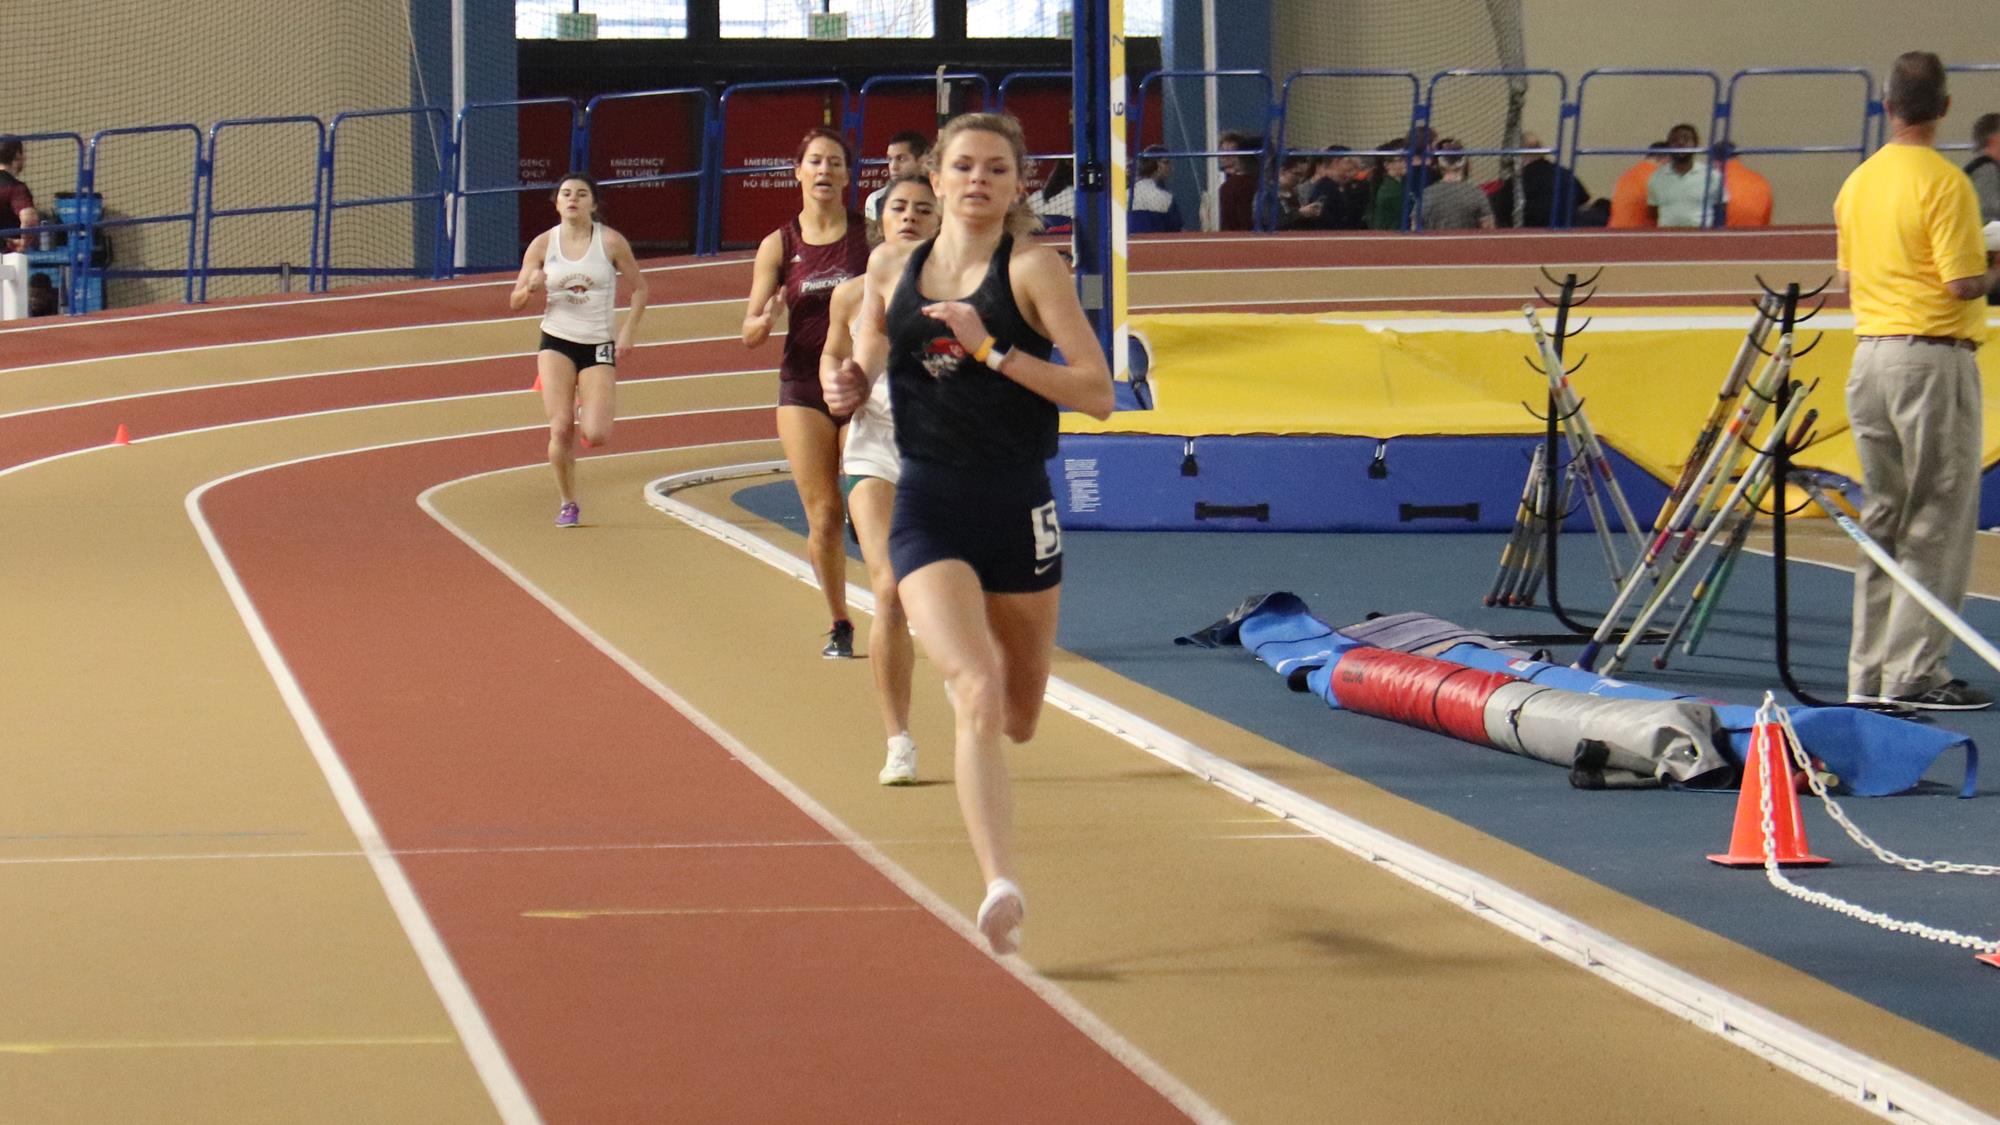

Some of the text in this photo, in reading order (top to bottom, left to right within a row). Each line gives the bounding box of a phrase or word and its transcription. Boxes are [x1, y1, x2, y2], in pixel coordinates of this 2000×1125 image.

[1113, 102, 1123, 116] 6
[610, 158, 665, 167] EMERGENCY
[861, 168, 879, 177] EXIT
[743, 180, 758, 188] NO
[600, 345, 610, 361] 4
[1041, 508, 1058, 554] 5
